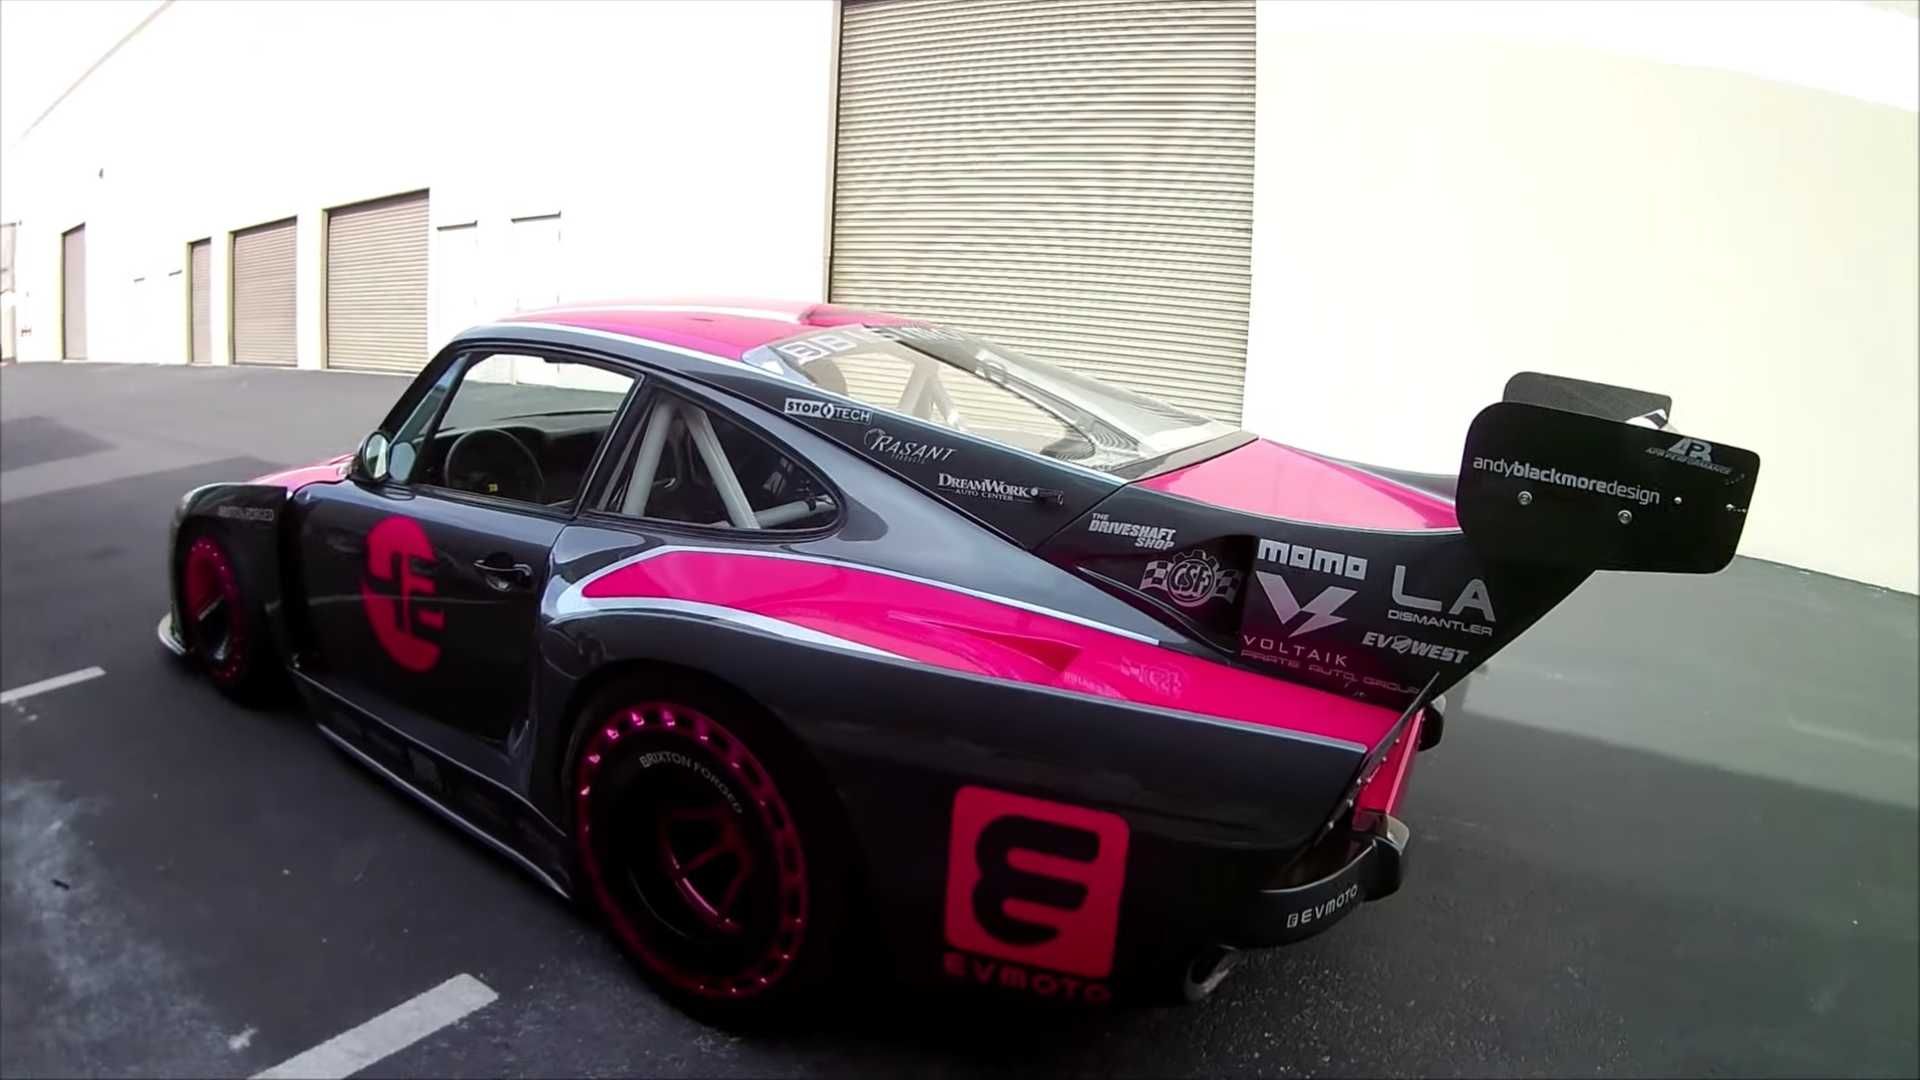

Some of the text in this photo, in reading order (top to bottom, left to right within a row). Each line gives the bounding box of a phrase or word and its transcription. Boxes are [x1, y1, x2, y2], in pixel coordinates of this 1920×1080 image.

[869, 435, 958, 461] RASANT
[1472, 455, 1661, 505] andyblackmoredesign
[956, 489, 1014, 501] AUTO CENTER
[1092, 513, 1110, 521] THE
[1088, 519, 1177, 541] DRIVESHAFT
[1134, 537, 1175, 550] SHOP
[1387, 609, 1494, 637] DISMANTLER
[1243, 634, 1348, 667] VOLTAIK
[640, 750, 692, 768] BRIXTON
[943, 951, 1112, 1005] EVMOTO
